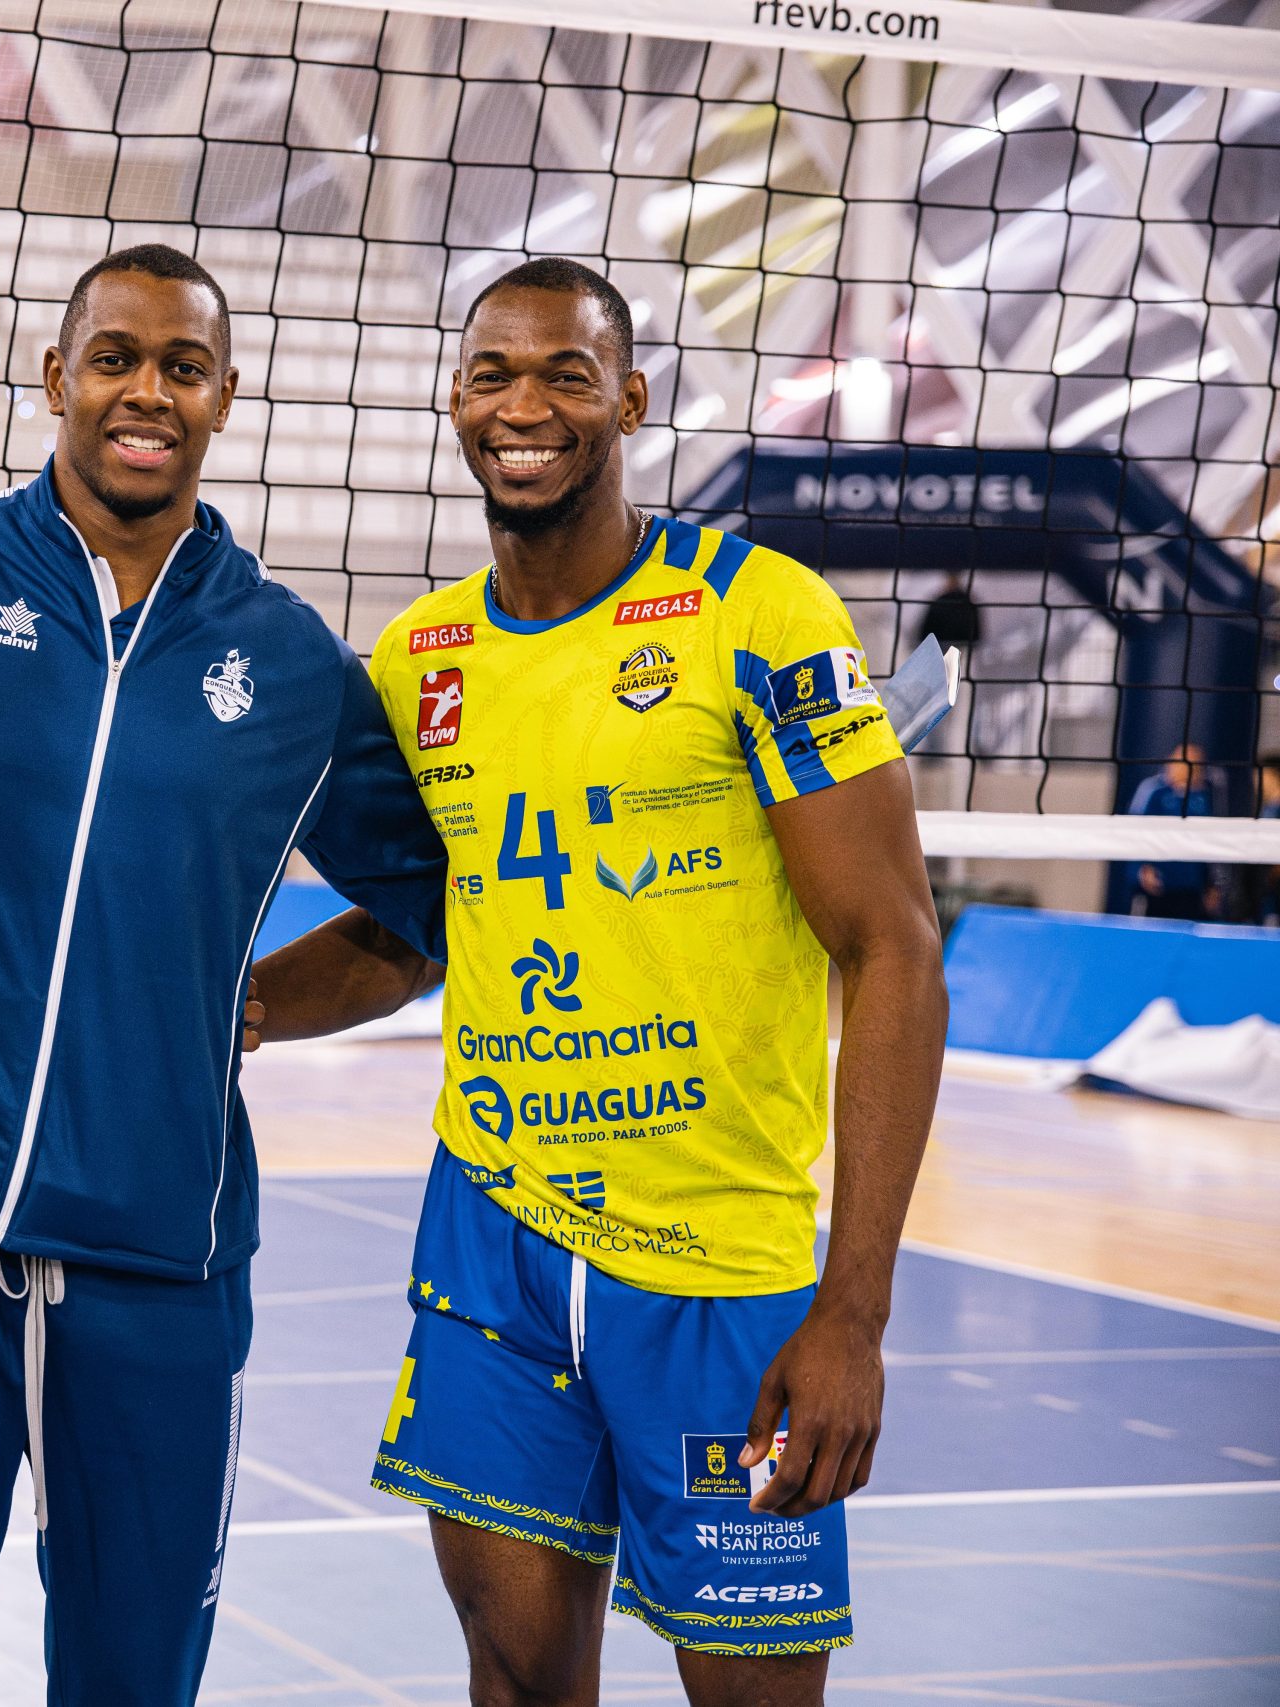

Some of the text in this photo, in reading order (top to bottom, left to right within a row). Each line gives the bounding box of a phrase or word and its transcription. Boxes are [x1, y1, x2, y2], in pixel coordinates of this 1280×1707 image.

[753, 0, 940, 41] rfevb.com
[793, 474, 1044, 512] NOVOTEL
[620, 595, 699, 621] FIRGAS.
[413, 625, 473, 650] FIRGAS.
[611, 672, 678, 694] GUAGUAS
[619, 667, 672, 683] CLUB VOLEIBOL
[205, 679, 251, 705] CONQUERIDOR
[819, 697, 830, 706] de
[420, 726, 457, 746] SVM
[620, 790, 648, 798] Instituto
[648, 786, 681, 795] Municipal
[681, 784, 696, 793] para
[703, 776, 733, 787] Promoción
[640, 795, 671, 803] Actividad
[700, 786, 725, 796] Deporte
[645, 803, 671, 812] Palmas
[682, 799, 700, 807] Gran
[701, 794, 726, 803] Canaria
[444, 814, 475, 825] Palmas
[448, 825, 478, 837] Canaria
[497, 792, 571, 910] 4
[666, 846, 723, 877] AFS
[456, 874, 484, 895] FS
[643, 879, 740, 899] Aula Formación Superior
[458, 1013, 697, 1063] GranCanaria
[520, 1077, 707, 1126] GUAGUAS
[537, 1121, 692, 1145] PARA TODO. PARA TODOS.
[546, 1226, 629, 1252] ÁNTICO
[656, 1222, 699, 1243] DEL
[691, 1485, 747, 1494] Gran Canaria
[695, 1477, 740, 1486] Cabildo de
[721, 1520, 805, 1538] Hospitales
[722, 1532, 822, 1551] SAN ROQUE
[722, 1554, 808, 1565] UNIVERSITARIOS
